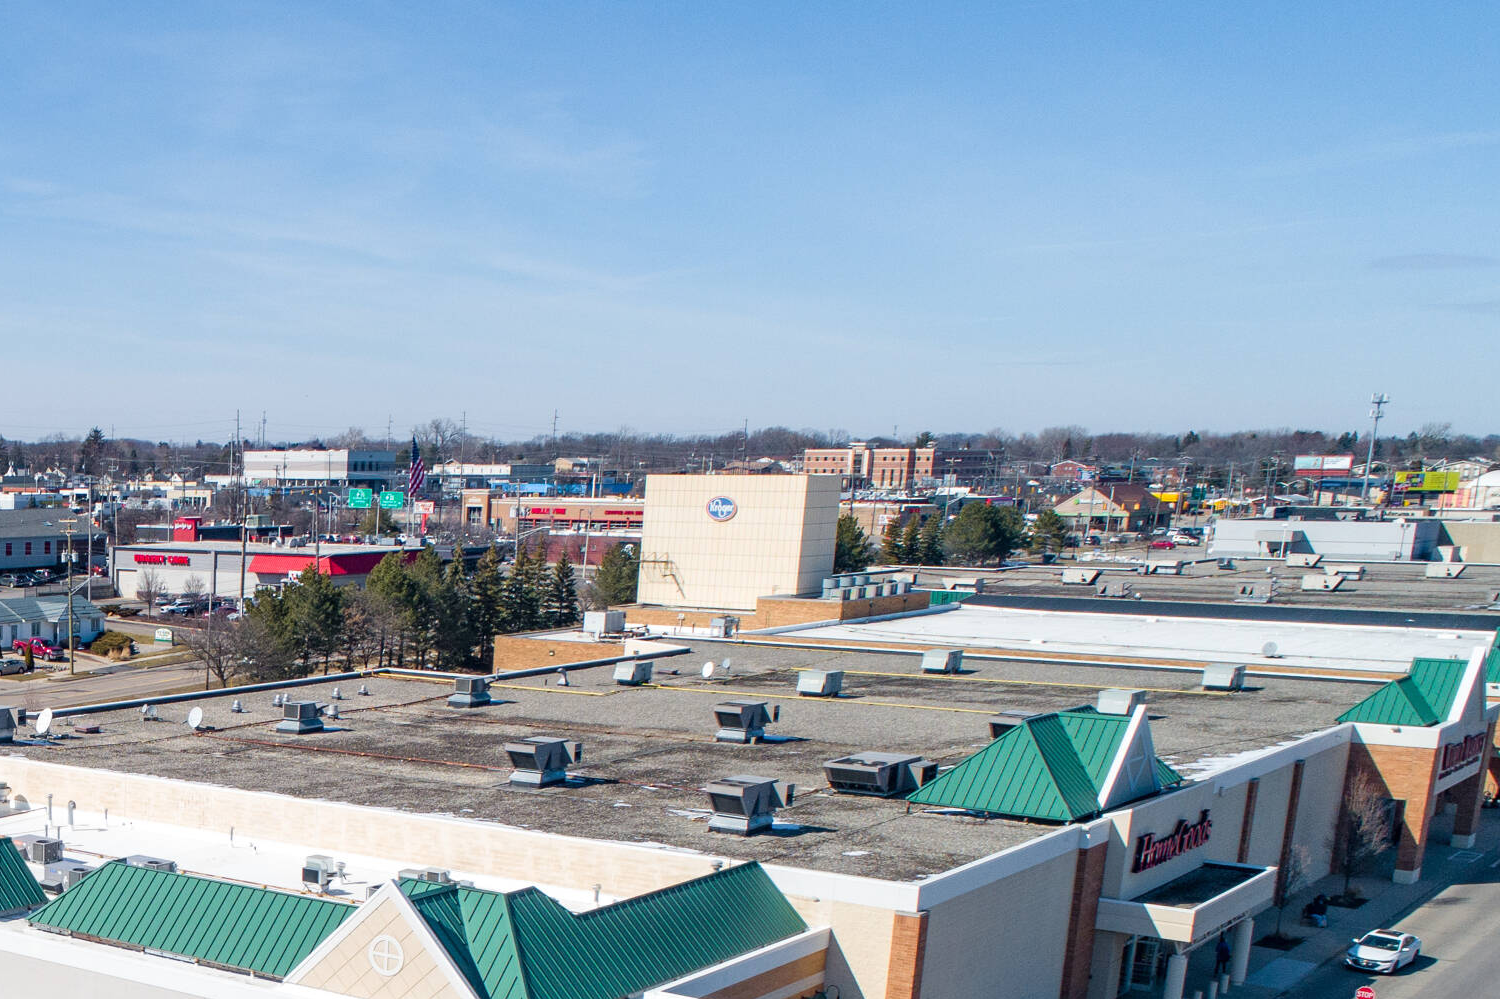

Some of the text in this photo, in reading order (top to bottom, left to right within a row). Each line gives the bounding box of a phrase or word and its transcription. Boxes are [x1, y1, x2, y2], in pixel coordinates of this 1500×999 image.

[709, 500, 734, 518] Kroger
[134, 554, 189, 564] URGENT CARE
[1135, 816, 1212, 873] HomeGoods
